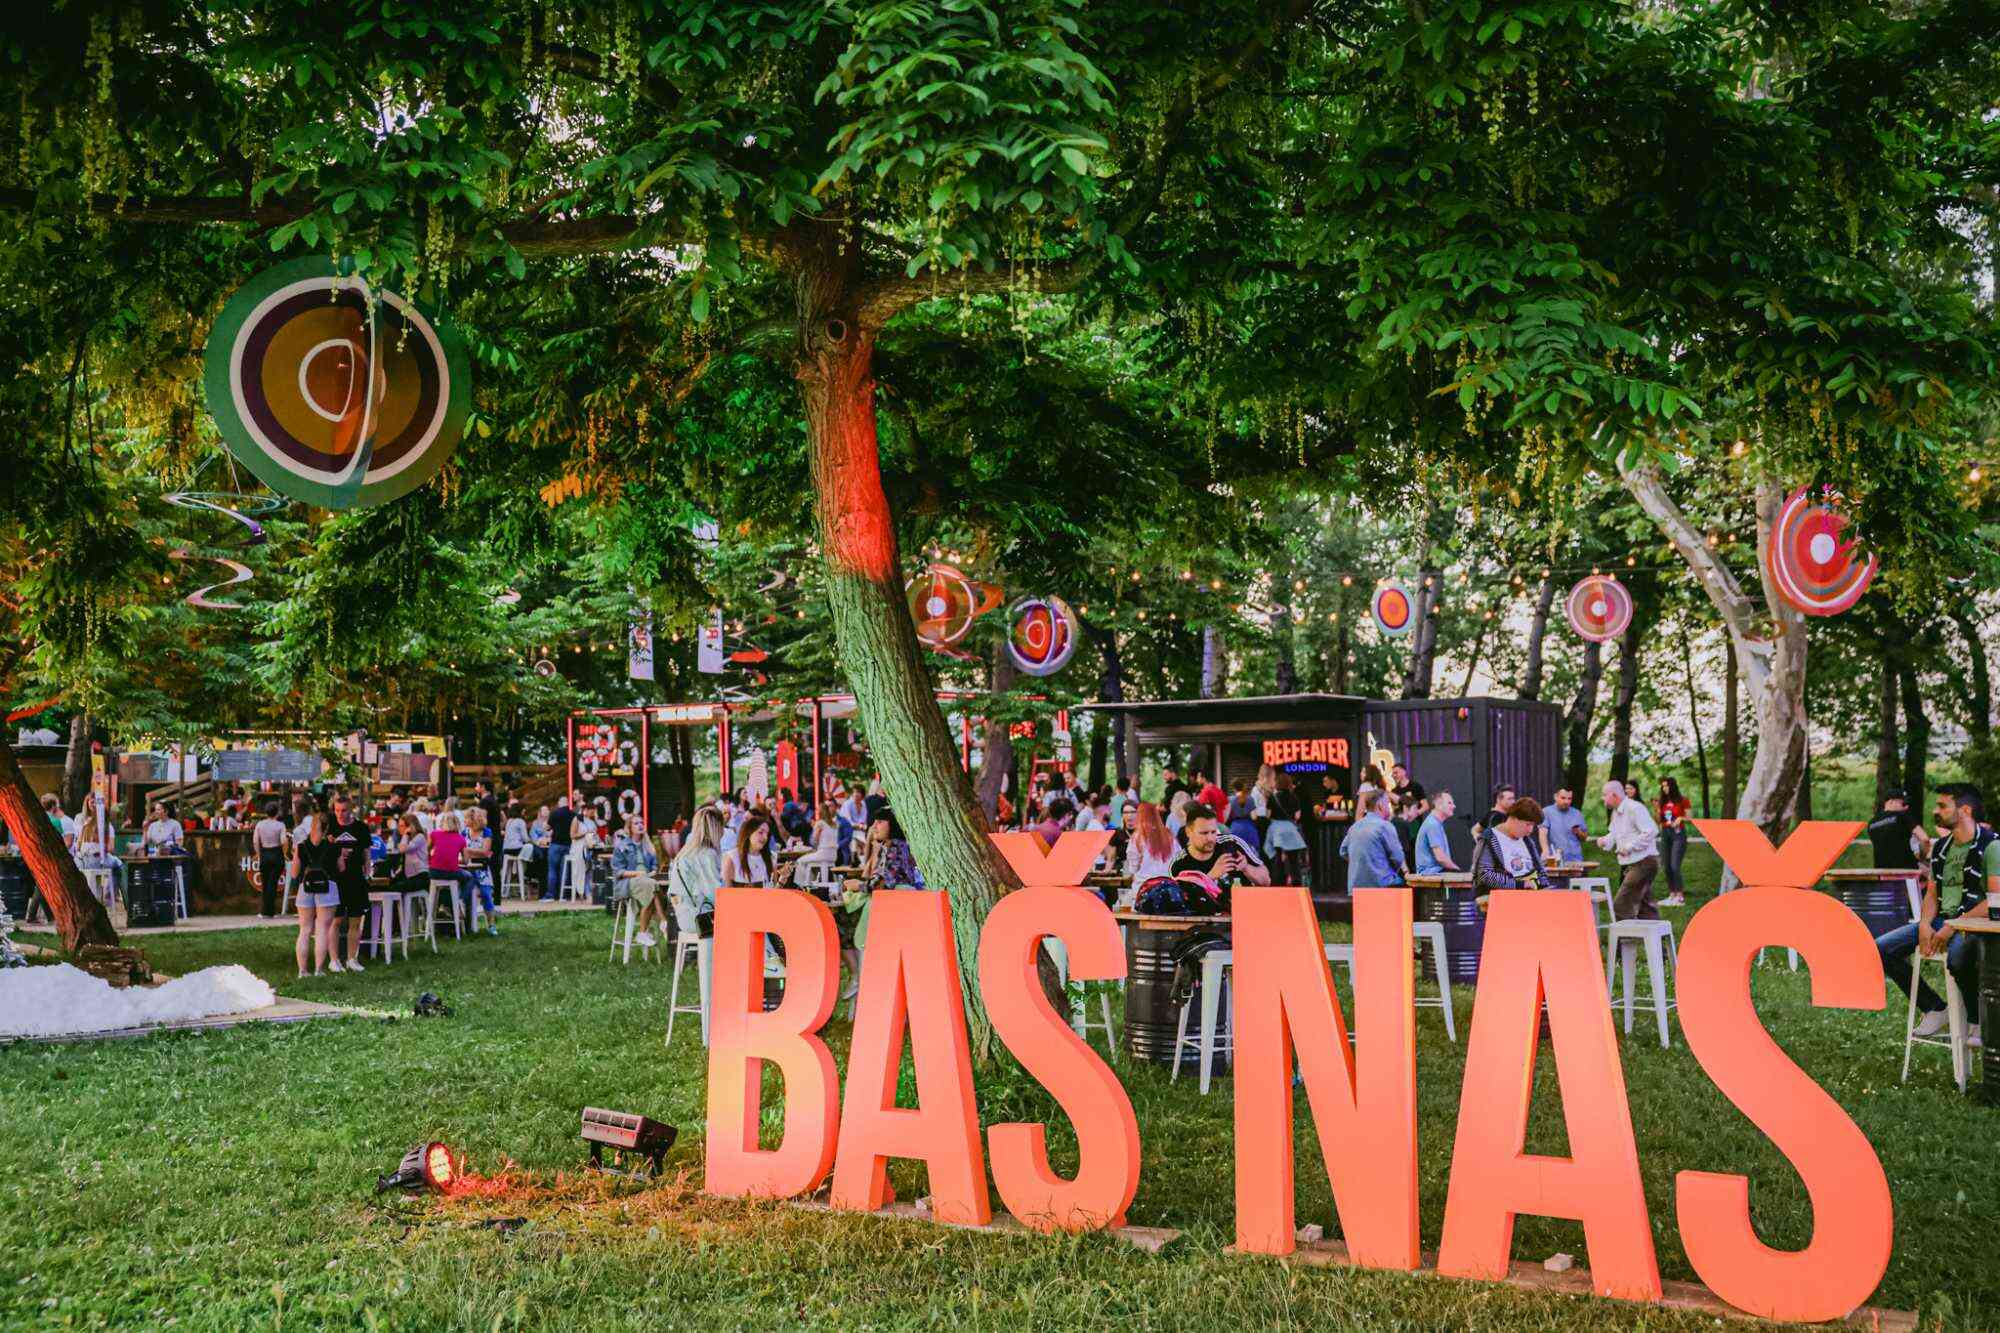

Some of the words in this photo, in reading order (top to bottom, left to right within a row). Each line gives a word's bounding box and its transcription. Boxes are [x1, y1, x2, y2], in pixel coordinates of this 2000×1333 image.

[1263, 738, 1350, 768] BEEFEATER
[1284, 763, 1327, 772] LONDON
[705, 830, 1141, 1233] BAŠ
[1231, 819, 1893, 1322] NAŠ
